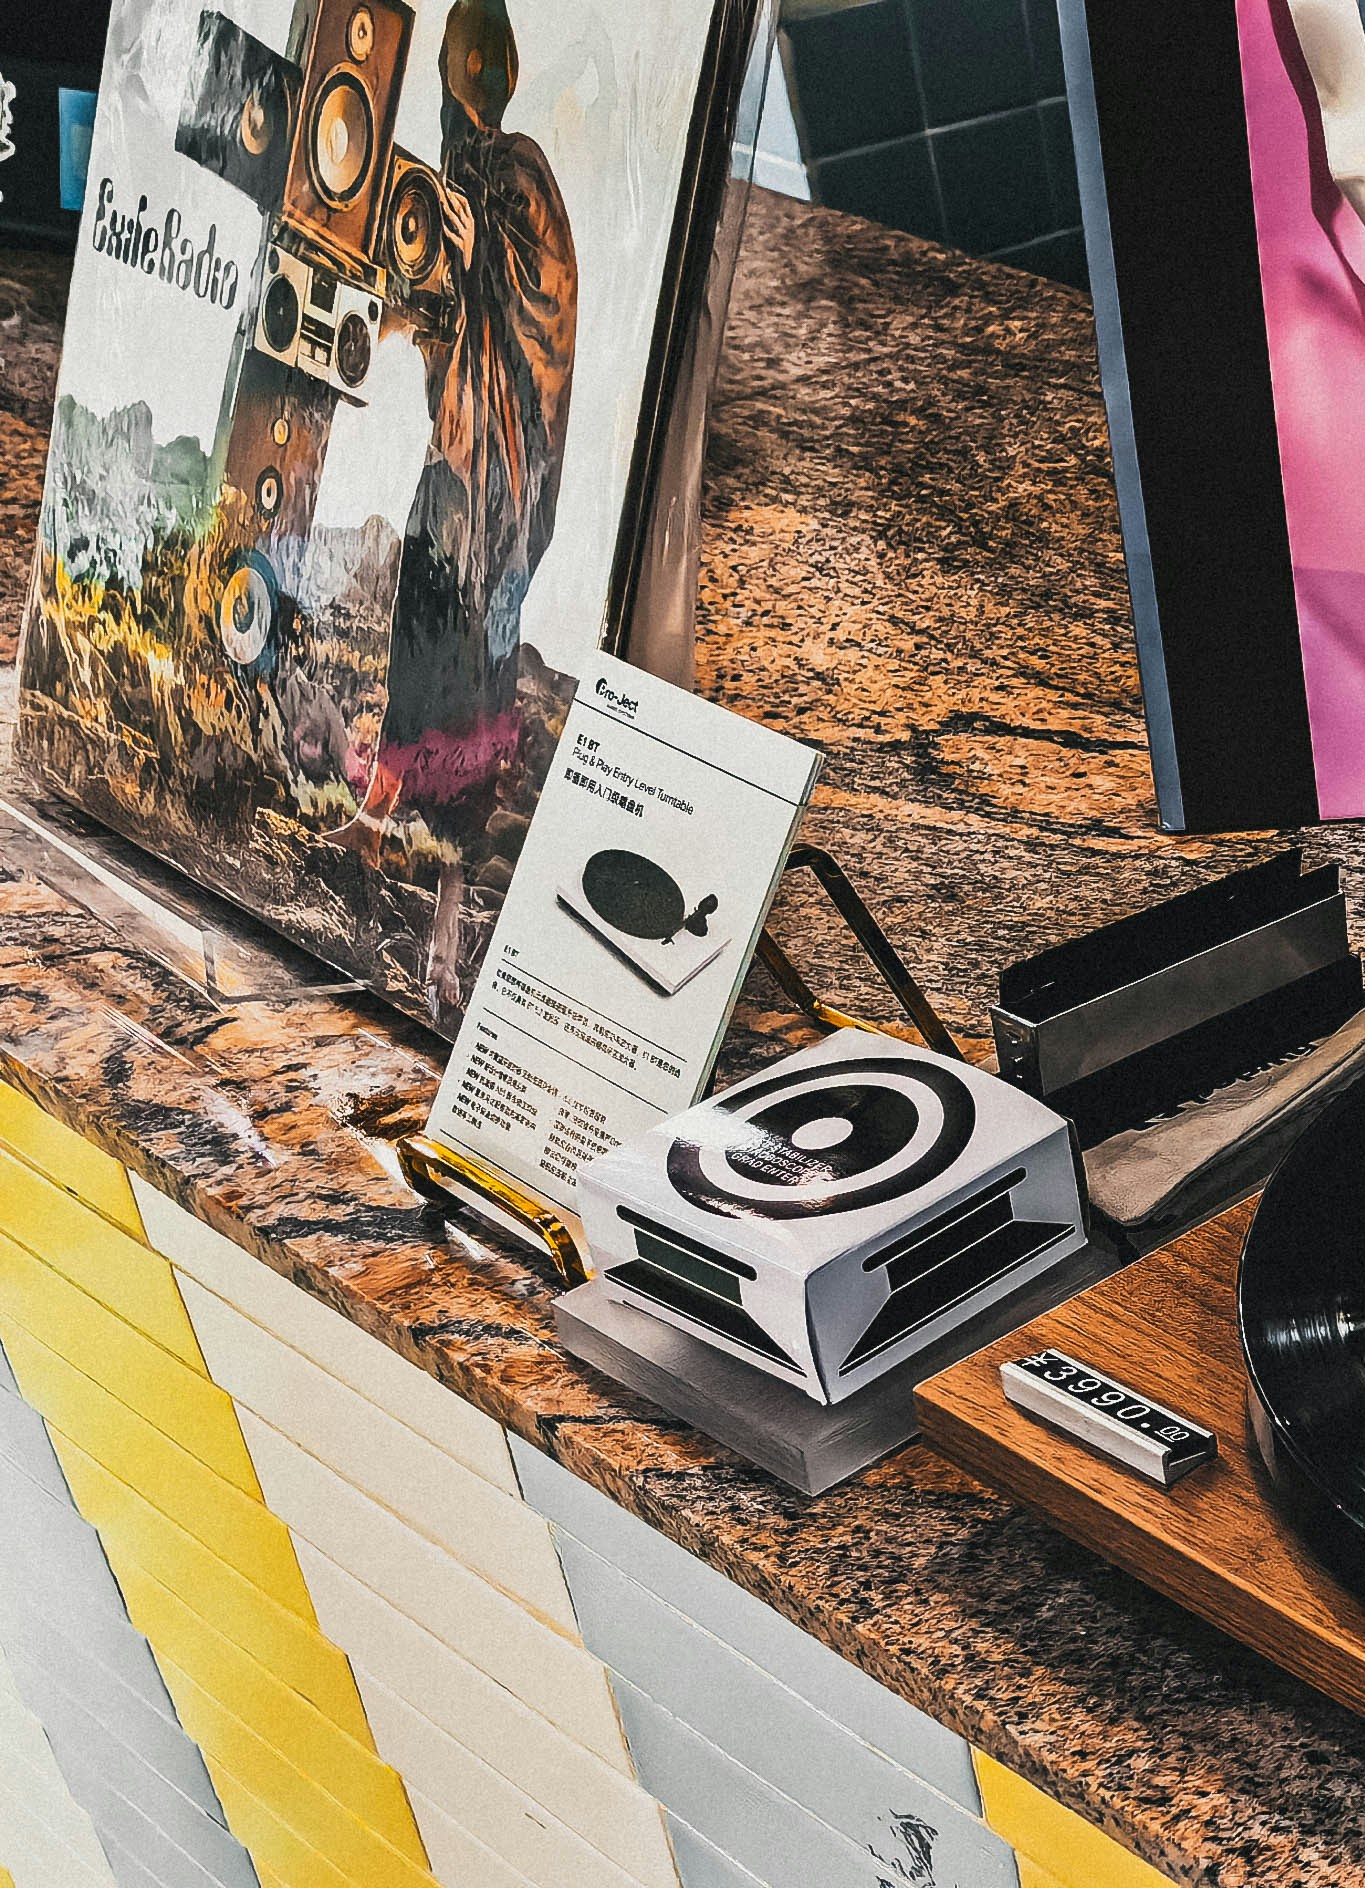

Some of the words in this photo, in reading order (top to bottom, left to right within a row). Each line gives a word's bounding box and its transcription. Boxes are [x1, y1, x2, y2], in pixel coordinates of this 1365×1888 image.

[93, 178, 159, 275] Exile
[159, 208, 238, 310] Radio
[587, 738, 601, 752] BT
[572, 746, 589, 765] Plug
[588, 755, 596, 766] &
[596, 758, 613, 777] Play
[612, 766, 635, 787] Entry
[634, 778, 657, 796] Level
[657, 787, 694, 815] Turntable
[743, 1145, 813, 1177] TROBOSCOP
